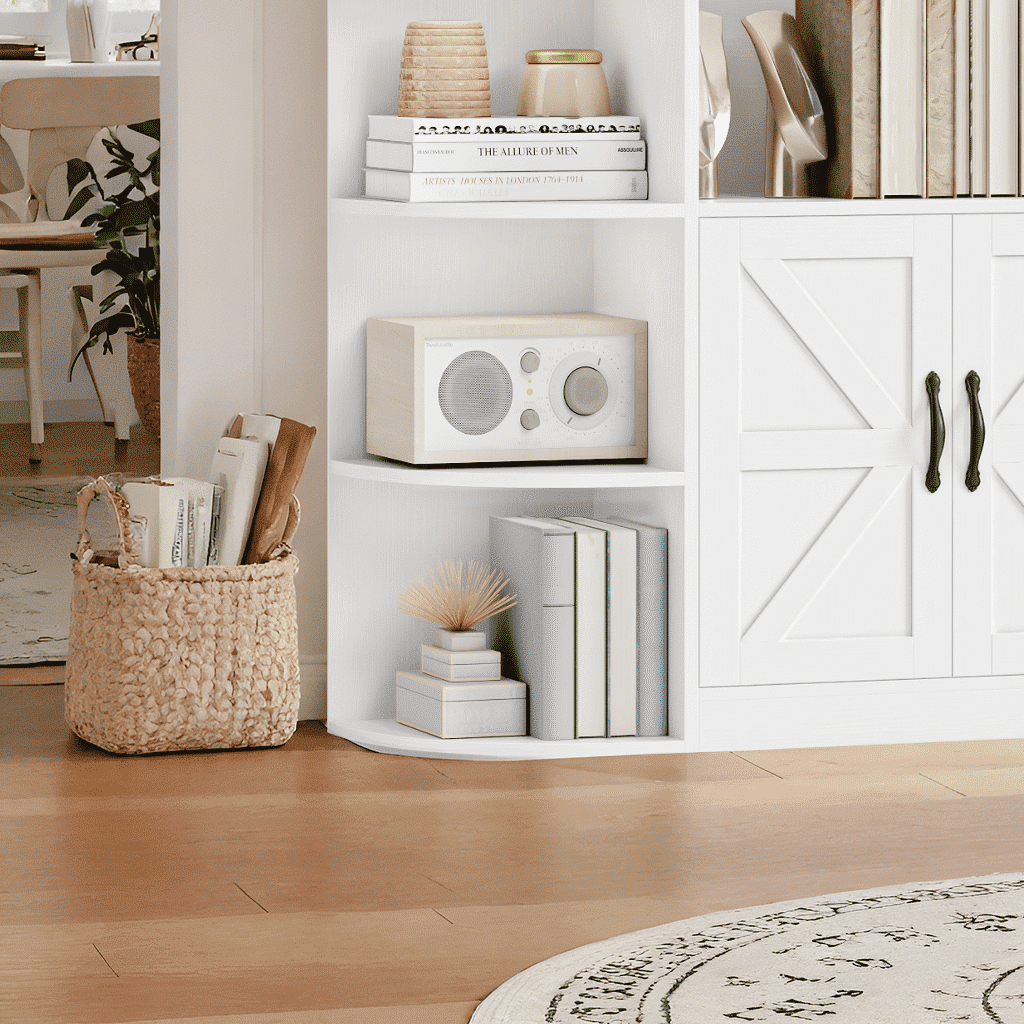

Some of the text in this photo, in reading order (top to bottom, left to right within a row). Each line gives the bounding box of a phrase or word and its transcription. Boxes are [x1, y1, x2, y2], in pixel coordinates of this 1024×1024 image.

[477, 145, 579, 157] THE ALLURE OF MEN
[460, 177, 493, 185] HOUSES
[495, 176, 504, 184] IN
[506, 176, 540, 184] LONDON
